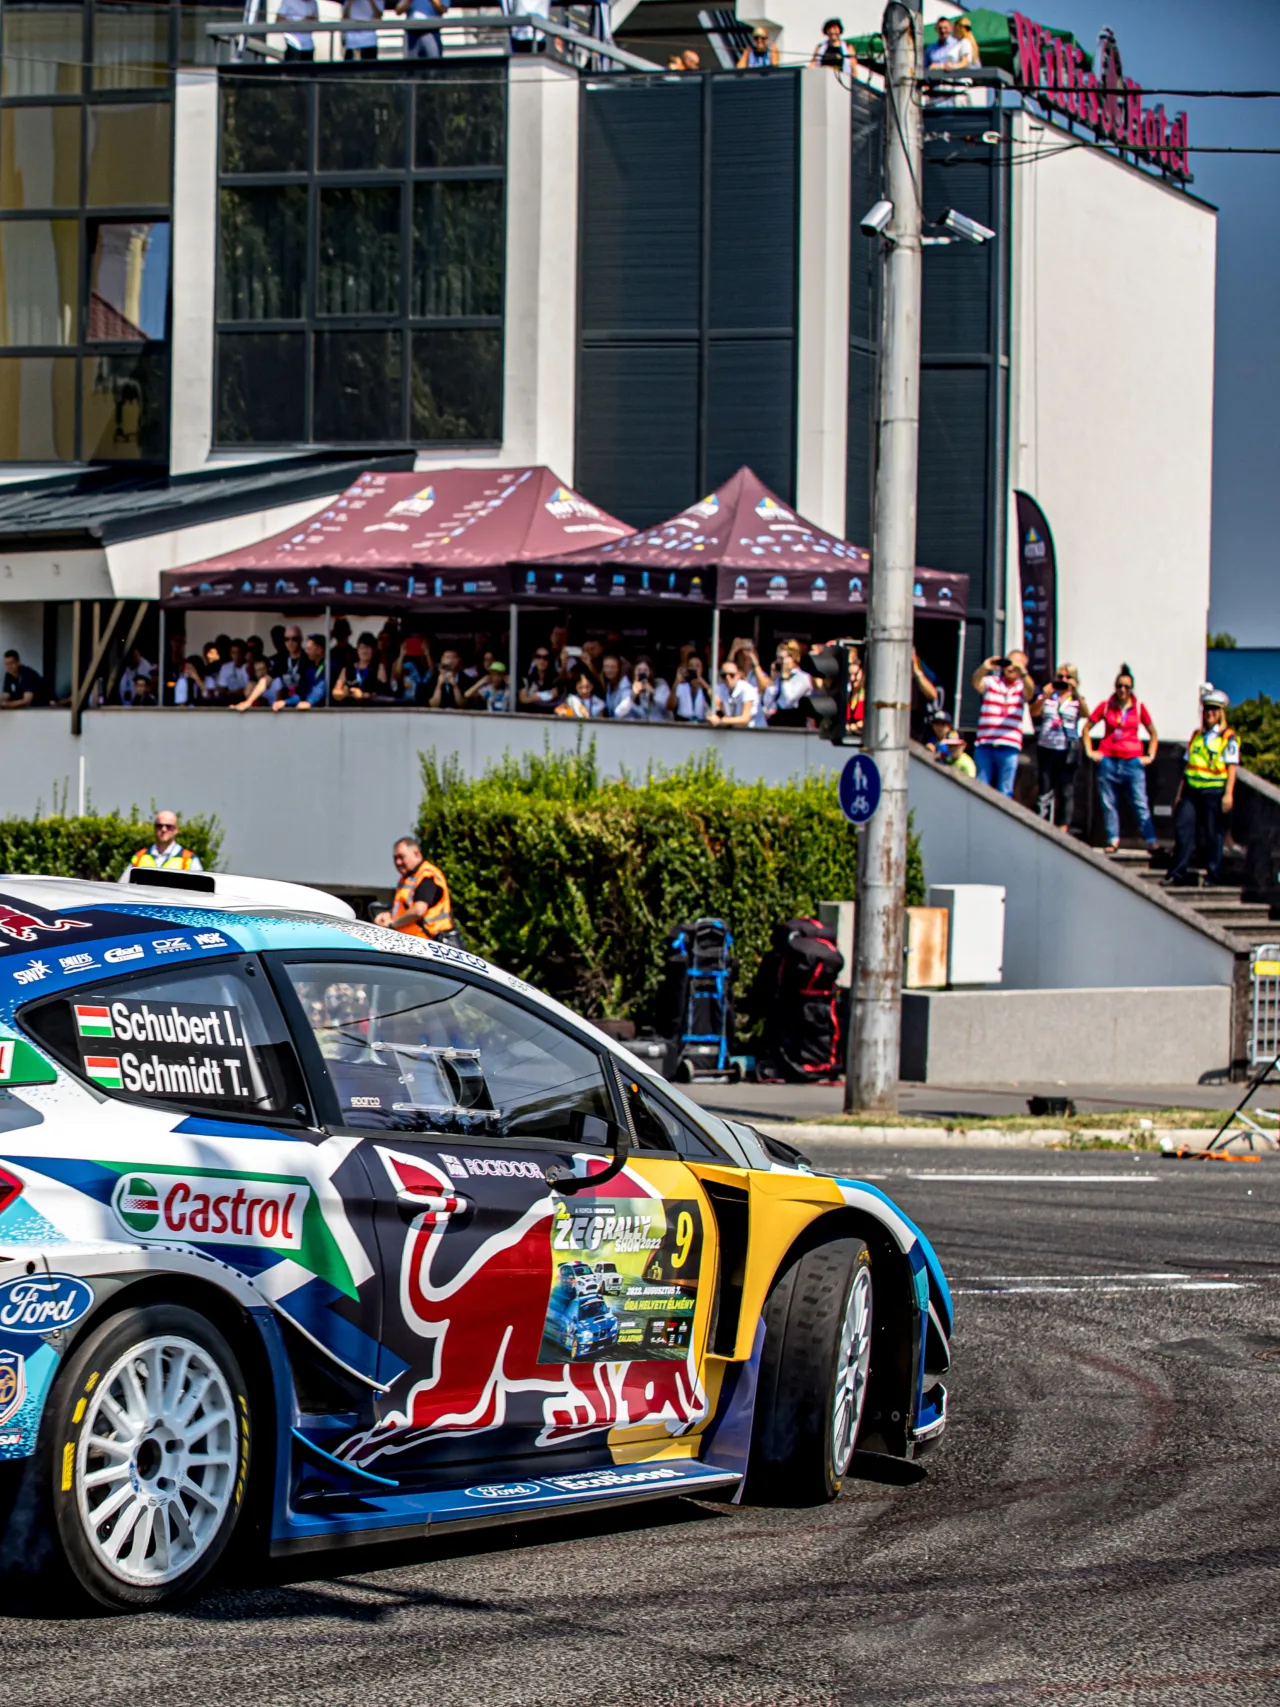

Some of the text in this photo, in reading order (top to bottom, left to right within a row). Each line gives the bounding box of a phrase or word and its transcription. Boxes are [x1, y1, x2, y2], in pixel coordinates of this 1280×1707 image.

[1013, 11, 1190, 175] Willis Hotel
[152, 937, 187, 948] OZ
[193, 932, 225, 945] NGK
[58, 952, 94, 968] ENDLESS
[427, 942, 488, 971] sparco
[111, 1002, 244, 1047] Schubert I.
[121, 1052, 249, 1096] Schmidt T.
[463, 1157, 546, 1179] ROCKDOOR
[164, 1182, 297, 1240] Castrol
[556, 1201, 571, 1220] 2.
[639, 1237, 662, 1250] 2022
[671, 1211, 694, 1268] 9
[0, 1282, 77, 1325] Ford
[481, 1484, 531, 1498] Ford
[555, 1467, 686, 1492] EcoBoost
